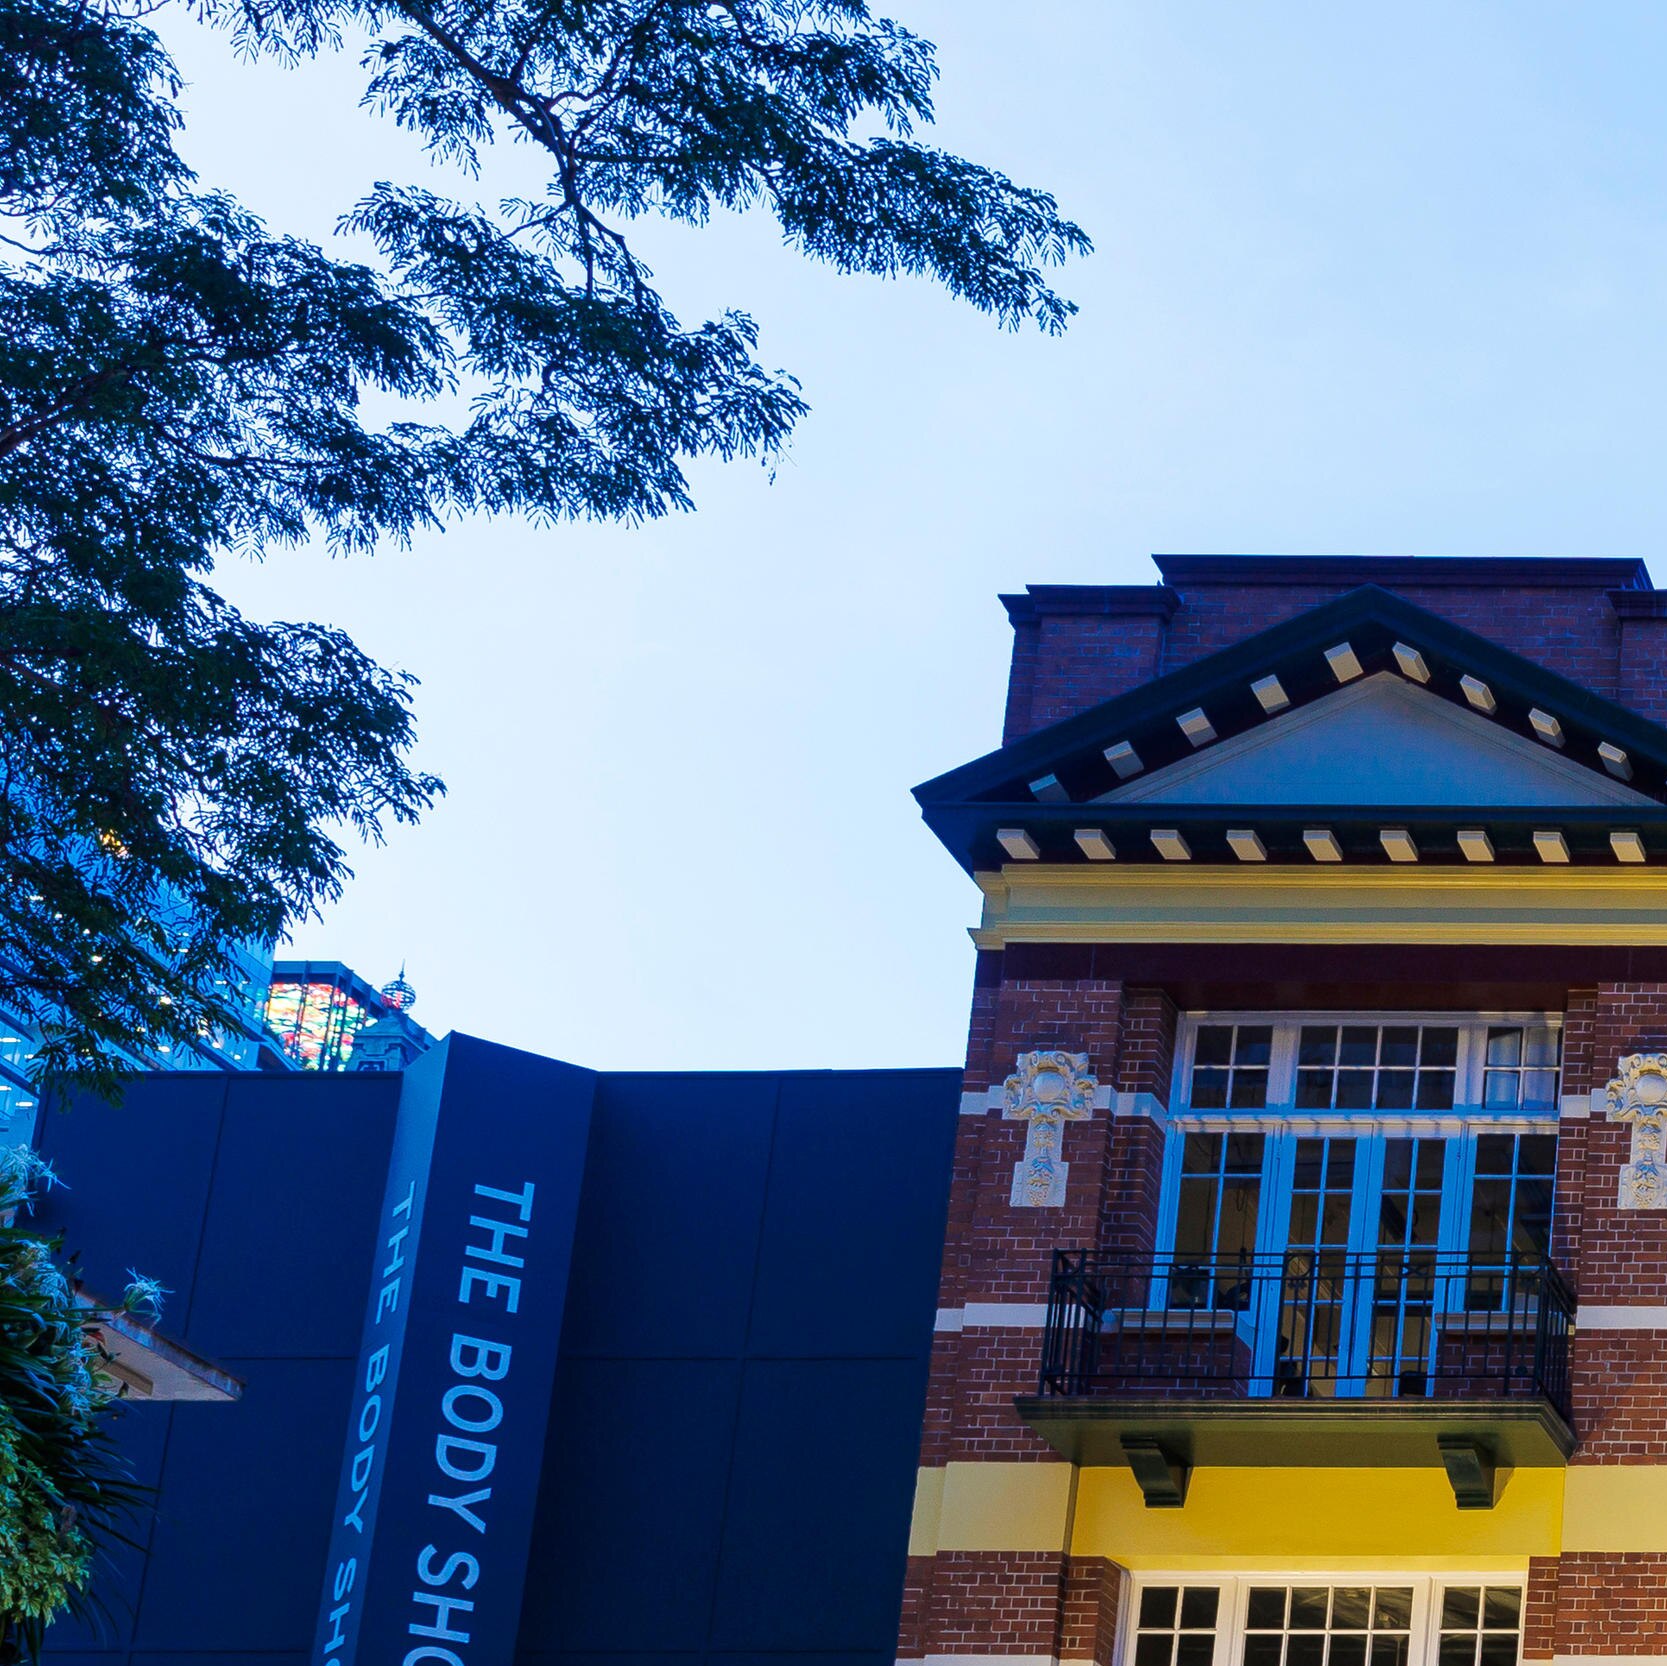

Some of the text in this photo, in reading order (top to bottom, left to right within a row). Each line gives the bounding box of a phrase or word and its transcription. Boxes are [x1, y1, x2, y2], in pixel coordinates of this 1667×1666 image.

[375, 1180, 416, 1325] THE
[458, 1182, 536, 1313] THE
[344, 1344, 390, 1534] BODY
[427, 1333, 513, 1534] BODY
